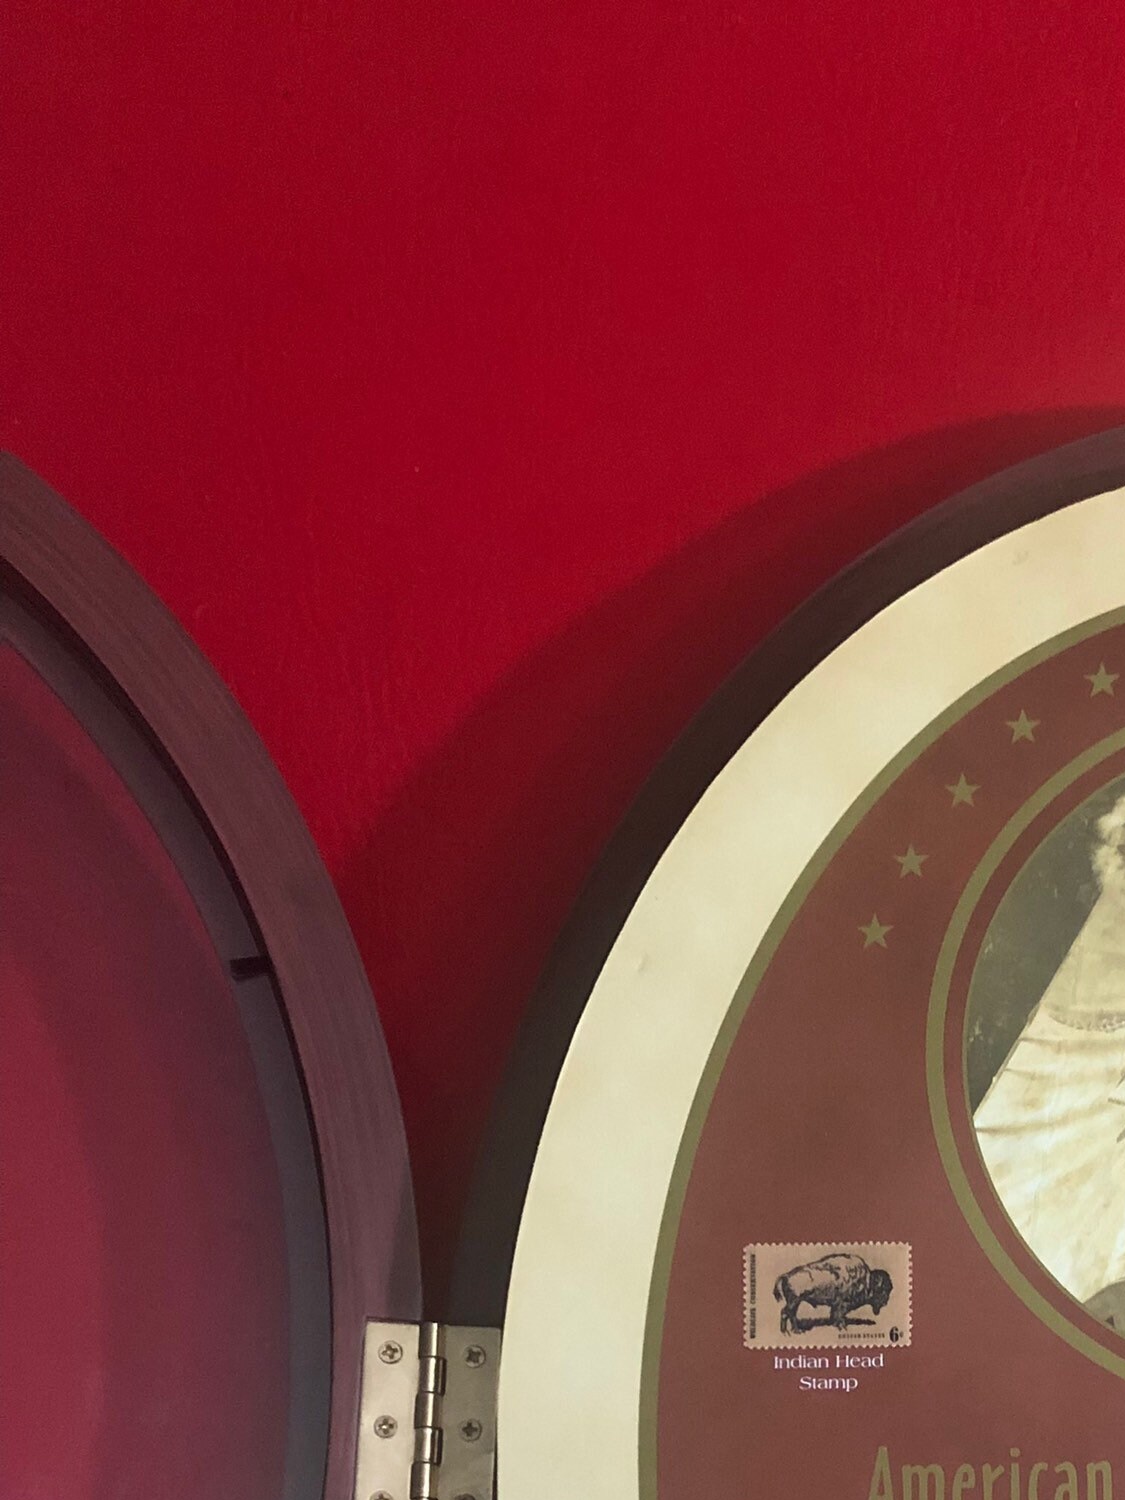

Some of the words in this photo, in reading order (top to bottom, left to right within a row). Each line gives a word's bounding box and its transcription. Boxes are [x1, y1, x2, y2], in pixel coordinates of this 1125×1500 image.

[774, 1354, 829, 1369] Indian
[836, 1353, 884, 1368] Head
[799, 1376, 858, 1392] Stamp
